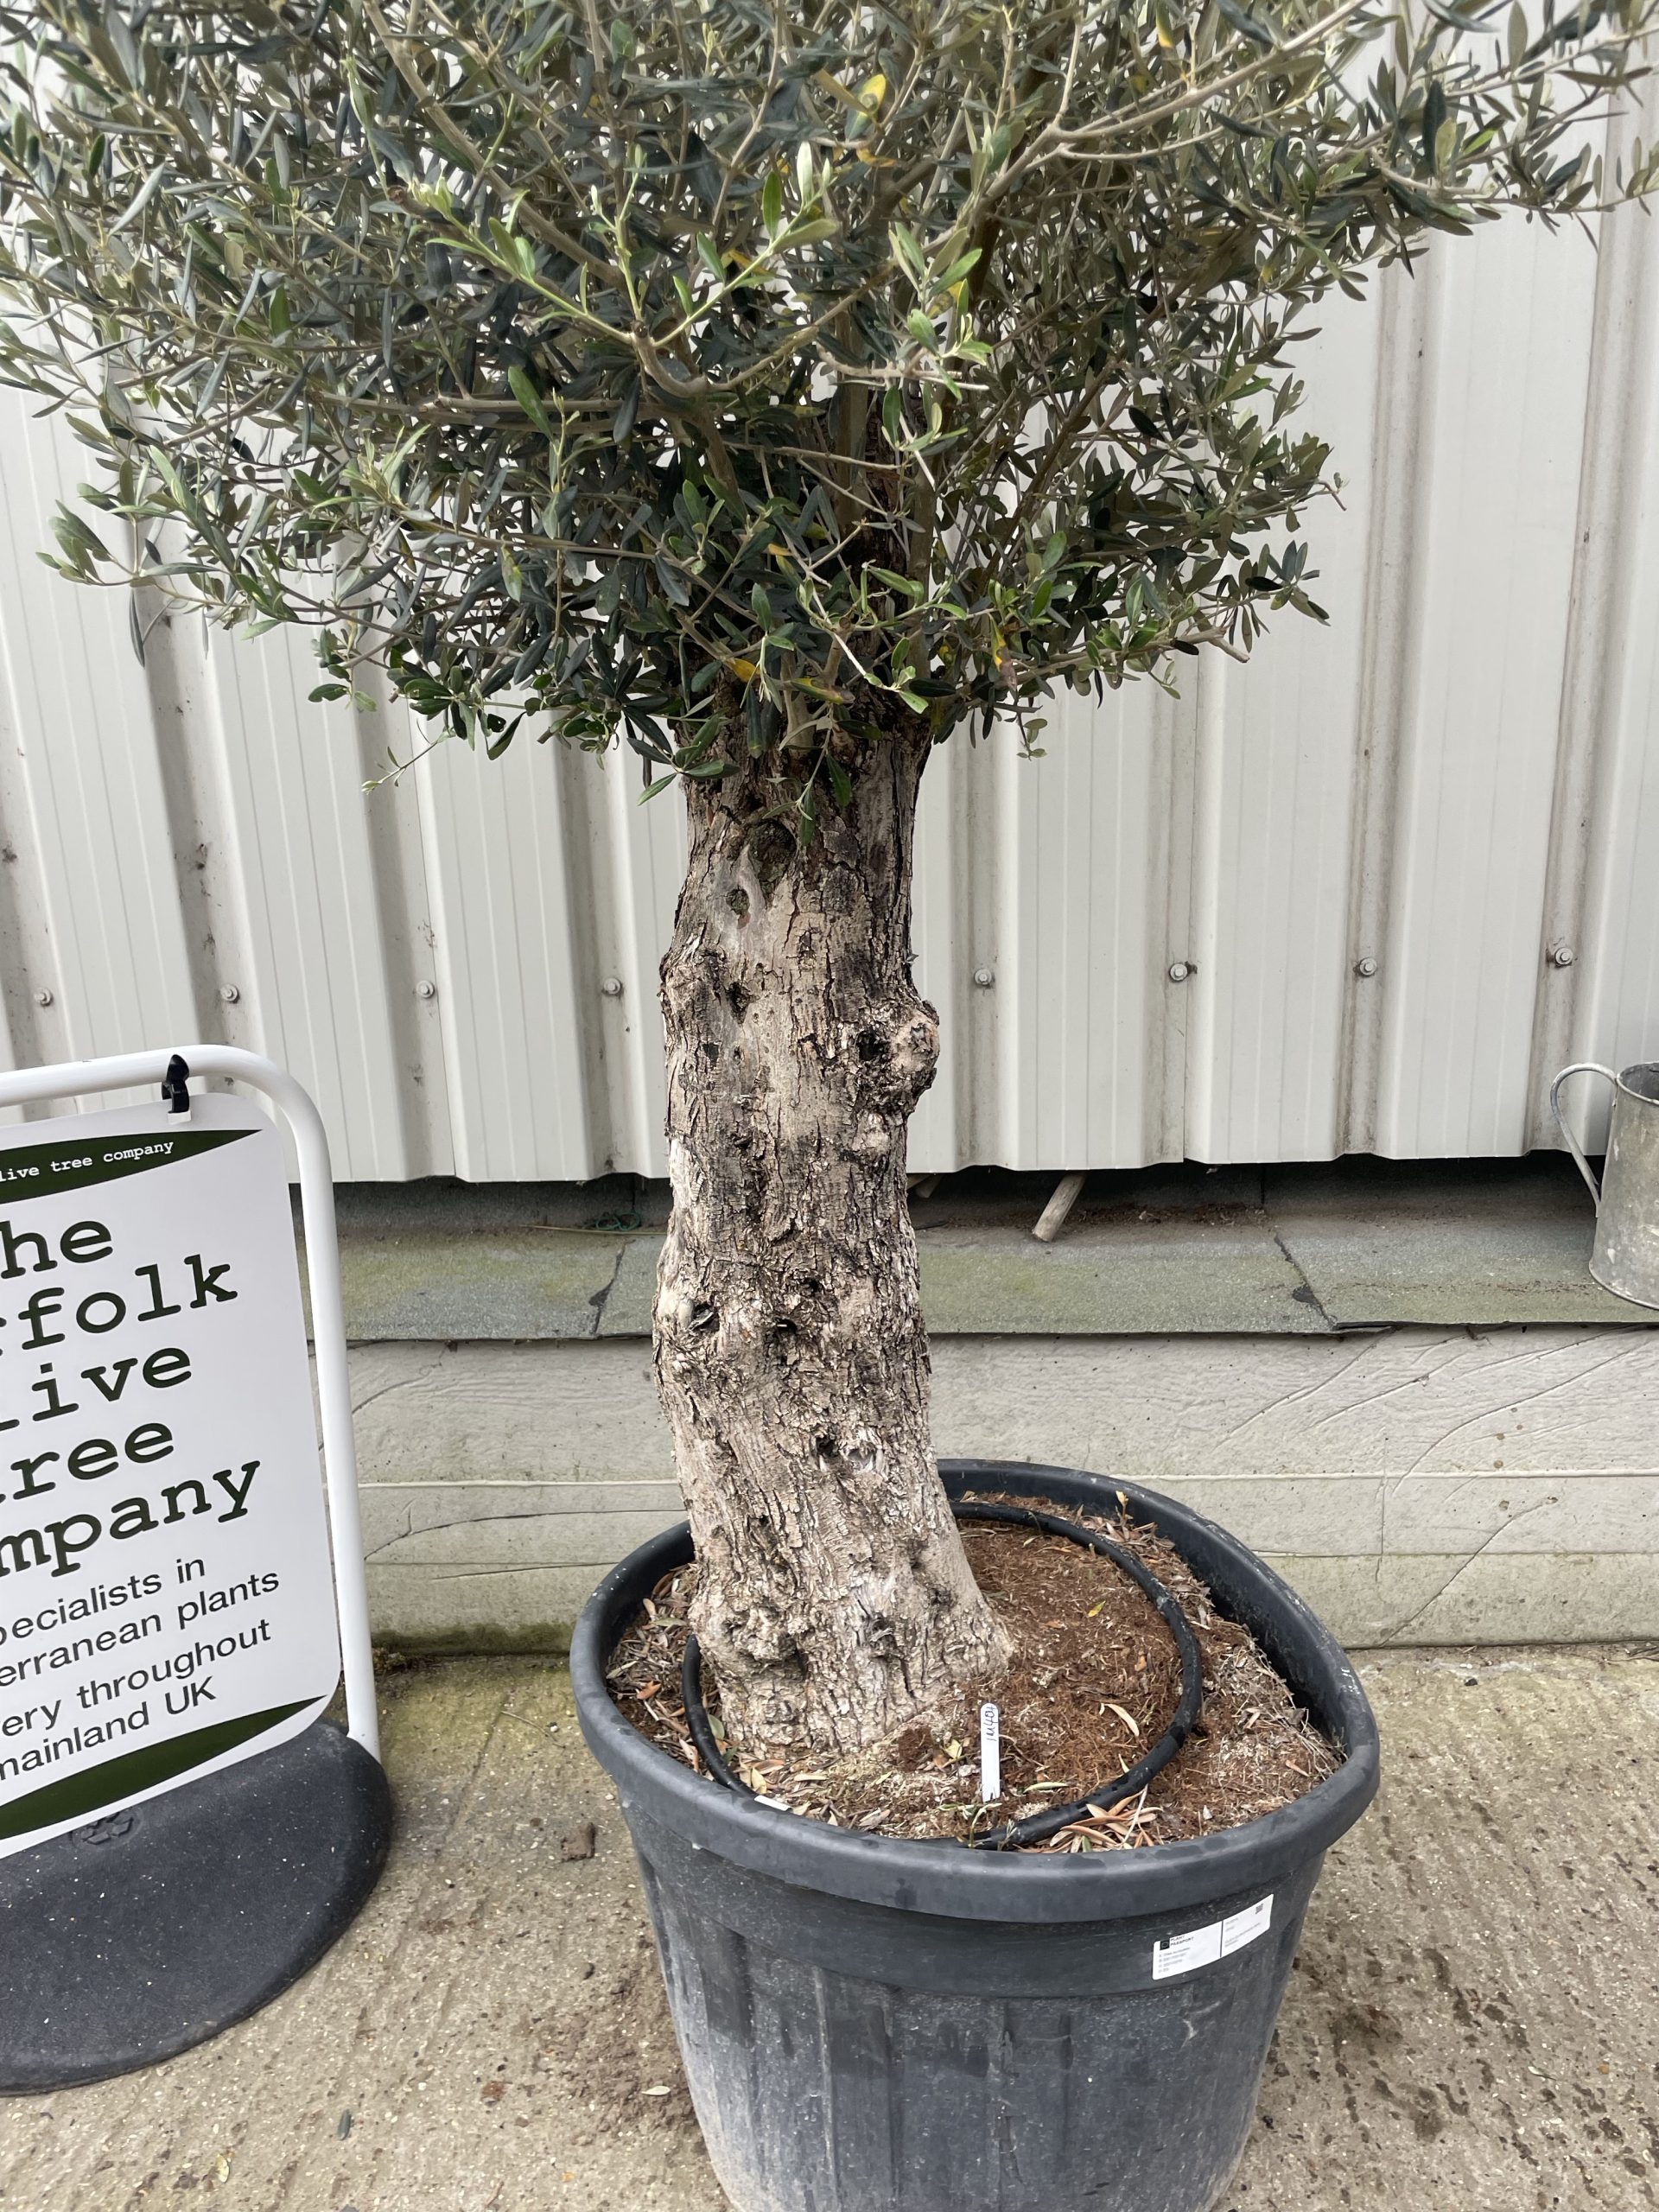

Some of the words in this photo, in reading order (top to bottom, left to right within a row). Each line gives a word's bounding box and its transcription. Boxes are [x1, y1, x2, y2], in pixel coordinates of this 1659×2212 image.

[51, 1156, 92, 1172] tree
[104, 1141, 174, 1162] company
[0, 1255, 238, 1351] folk
[0, 1423, 175, 1504] ree
[176, 1558, 206, 1584] in
[178, 1573, 279, 1630] plants
[77, 1618, 271, 1709] throughout
[165, 1676, 217, 1716] UK
